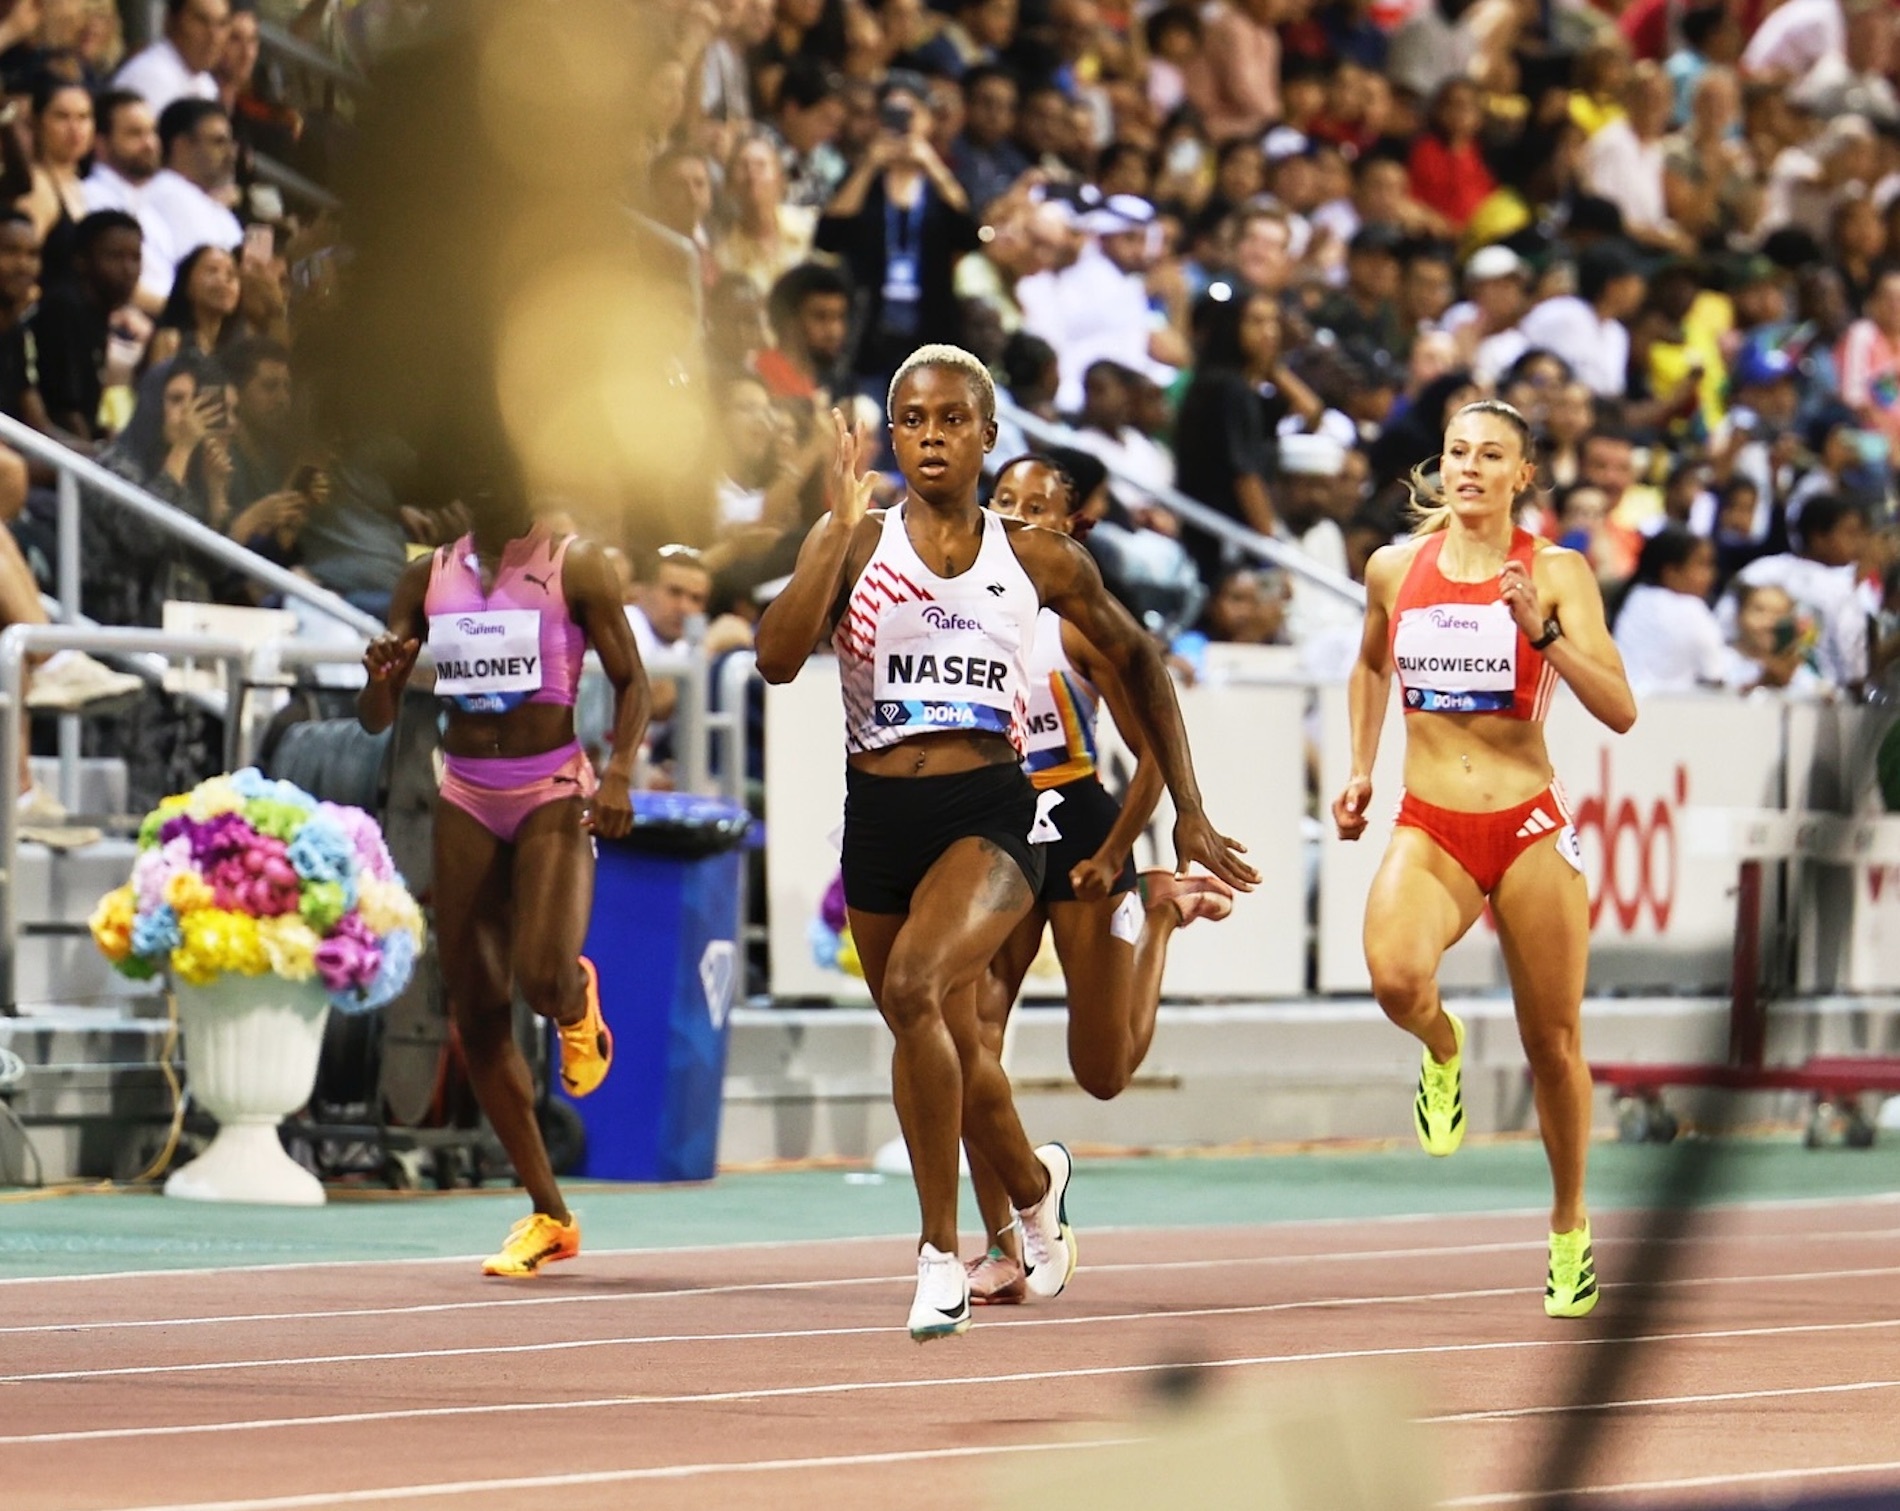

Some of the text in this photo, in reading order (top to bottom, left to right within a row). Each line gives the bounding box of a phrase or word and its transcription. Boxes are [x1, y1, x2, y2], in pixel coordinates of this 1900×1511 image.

[1430, 609, 1479, 632] Rafeeq
[437, 656, 537, 680] MALONEY
[888, 654, 1008, 692] NASER
[1397, 657, 1511, 672] BUKOWIECKA
[1432, 694, 1476, 709] DOHA
[923, 704, 975, 723] DOHA
